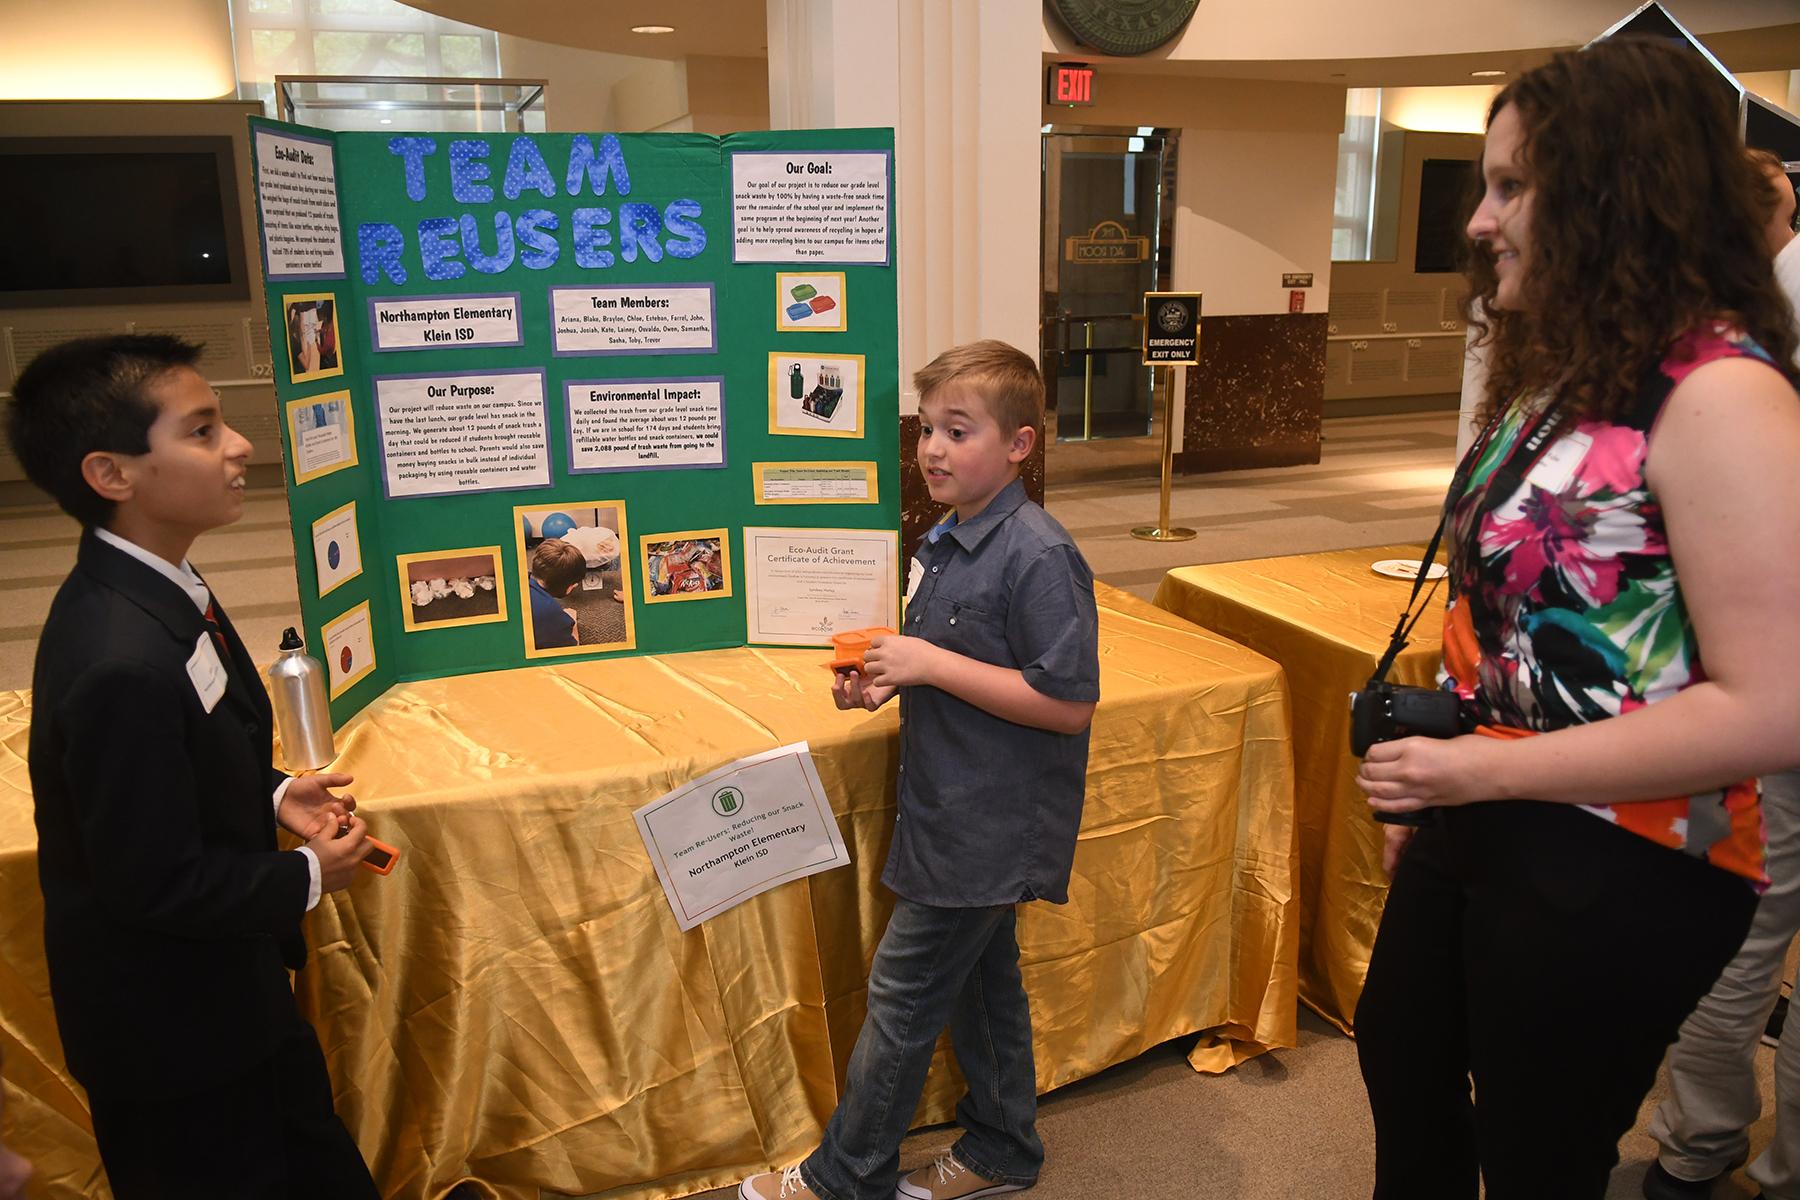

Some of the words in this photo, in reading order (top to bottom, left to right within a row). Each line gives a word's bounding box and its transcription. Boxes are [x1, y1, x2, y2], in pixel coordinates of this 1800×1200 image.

[1092, 1, 1162, 30] TEXAS
[1058, 69, 1092, 101] EXIT
[388, 134, 630, 203] TEAM
[786, 162, 804, 174] Our
[807, 162, 832, 174] Goal:
[794, 193, 801, 201] by
[802, 193, 820, 201] having
[796, 215, 822, 223] beginning
[357, 199, 707, 286] REUSERS
[736, 237, 753, 245] adding
[770, 237, 793, 246] recycling
[591, 297, 617, 308] Team
[621, 296, 669, 308] Members:
[380, 309, 450, 323] Northampton
[454, 307, 512, 320] Elementary
[424, 329, 451, 342] Klein
[455, 328, 474, 340] ISD
[557, 327, 578, 335] Joshua,
[1149, 339, 1195, 347] EMERGENCY
[250, 364, 273, 377] 192
[428, 386, 447, 398] Our
[450, 385, 494, 398] Purpose:
[590, 388, 660, 402] Environmental
[664, 389, 701, 401] Impact:
[389, 406, 400, 414] Our
[402, 406, 422, 414] project
[659, 406, 674, 414] grade
[576, 418, 589, 426] daily
[494, 433, 516, 441] brought
[398, 472, 427, 480] packaging
[429, 470, 436, 478] by
[454, 467, 478, 475] reusable
[458, 478, 480, 486] bottles.
[789, 546, 828, 554] Eco-Audit
[830, 547, 854, 555] Grant
[768, 555, 810, 563] Certificate
[812, 555, 821, 563] of
[822, 556, 876, 566] Achievement
[673, 845, 695, 859] Team
[731, 813, 766, 831] Reducing
[768, 808, 780, 817] our
[781, 802, 805, 812] Snack
[728, 827, 754, 843] Waste!
[688, 842, 750, 878] Northampton
[751, 823, 807, 848] Elementary
[733, 854, 755, 868] Klein
[755, 848, 769, 861] ISD
